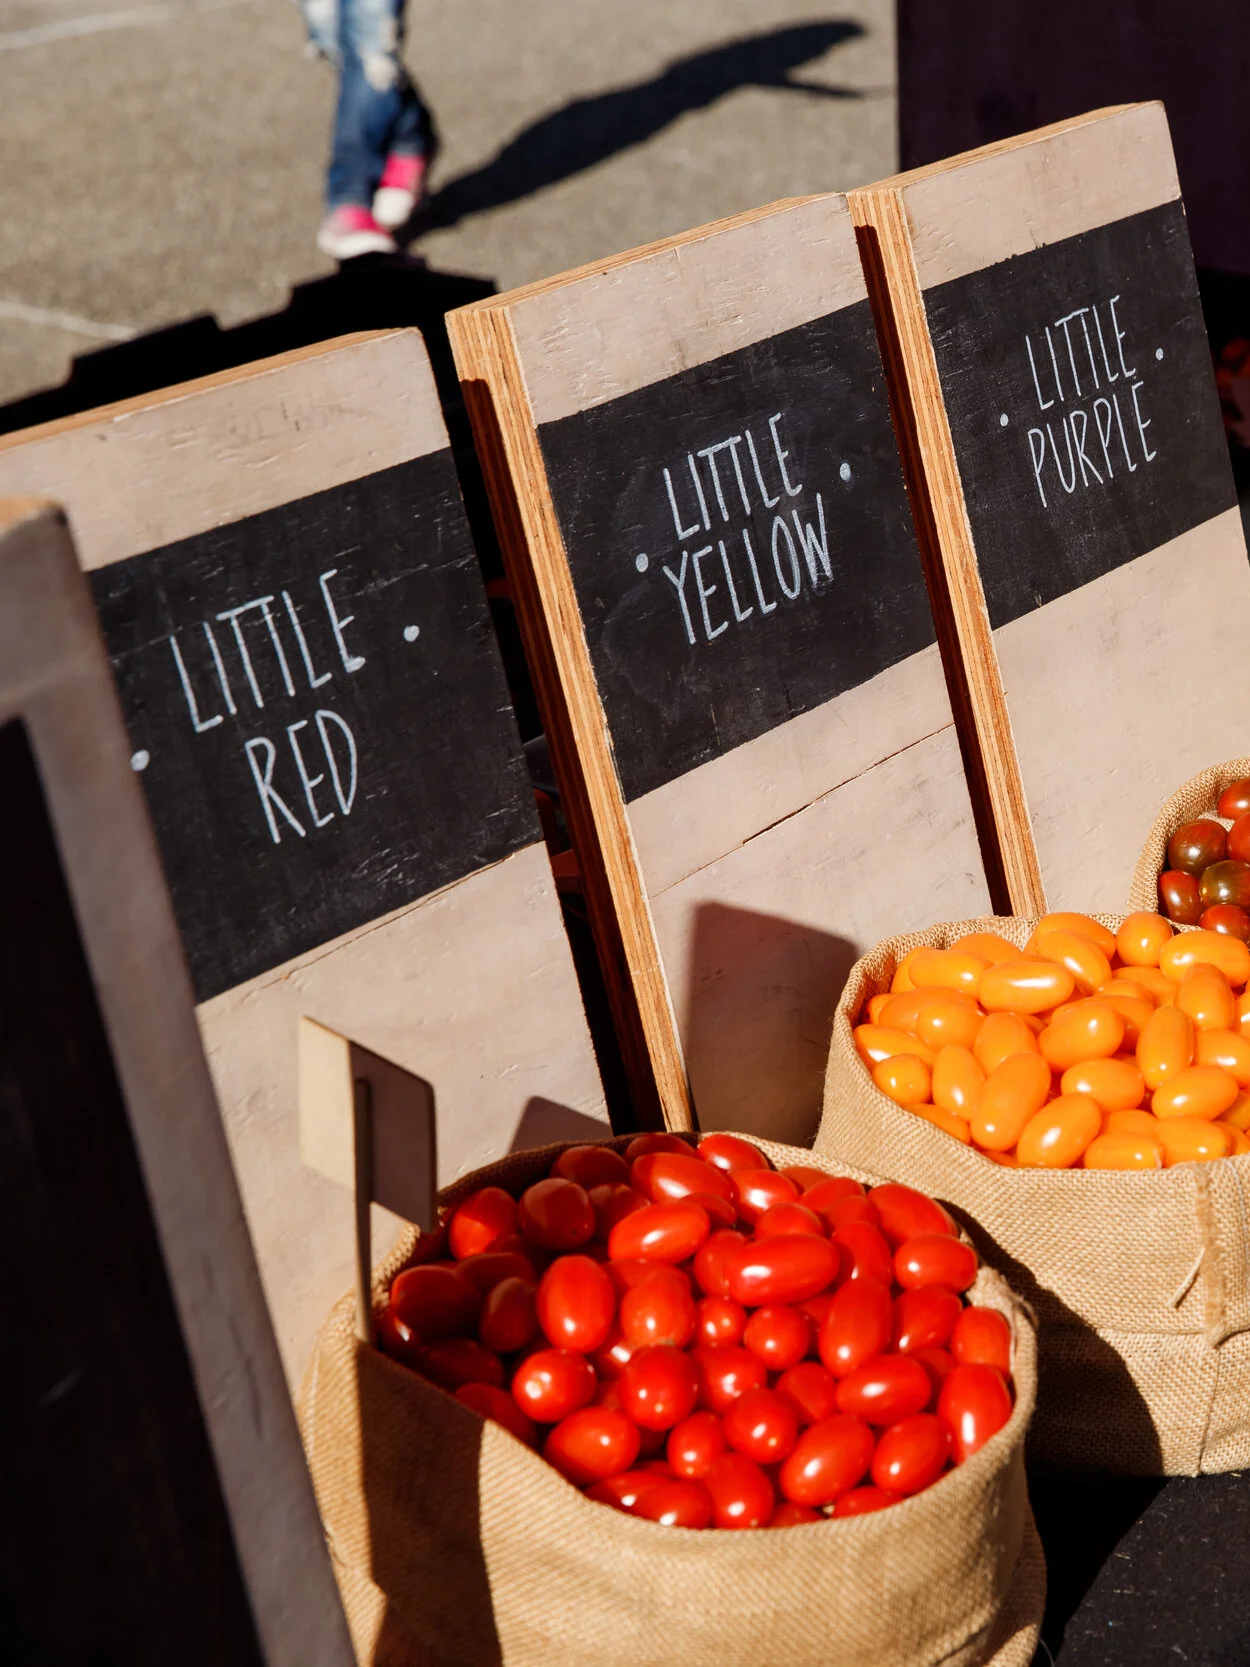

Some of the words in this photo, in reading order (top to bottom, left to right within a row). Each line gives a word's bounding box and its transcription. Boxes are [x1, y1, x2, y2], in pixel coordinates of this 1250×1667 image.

[1026, 294, 1136, 410] LITTLE
[663, 412, 802, 540] LITTLE
[1028, 381, 1157, 508] PURPLE
[663, 493, 834, 644] YELLOW
[170, 569, 366, 733] LITTLE
[245, 709, 358, 844] RED
